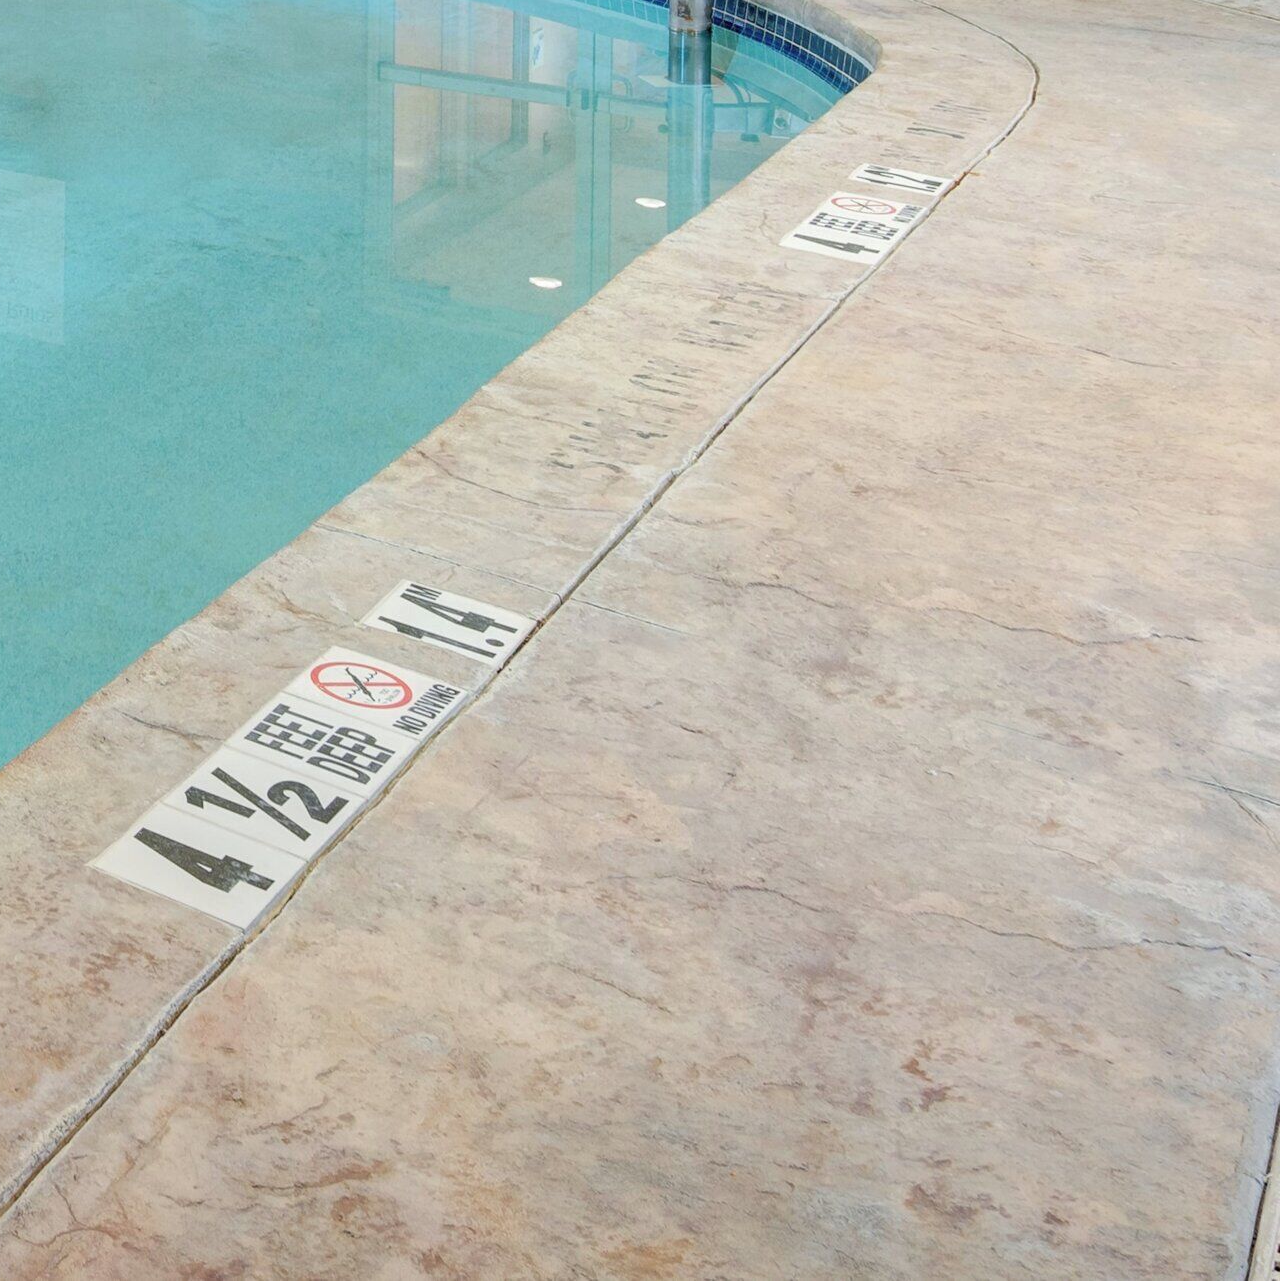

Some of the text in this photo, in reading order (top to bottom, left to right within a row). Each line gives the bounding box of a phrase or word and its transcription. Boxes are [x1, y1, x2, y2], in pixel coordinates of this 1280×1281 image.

[793, 233, 880, 254] 4
[809, 212, 858, 232] FEET
[850, 220, 899, 240] DEEP
[378, 583, 518, 658] 1.4 M
[244, 703, 334, 759] FEET
[392, 684, 460, 735] NO DIVING
[306, 726, 396, 785] DEEP
[134, 767, 350, 893] 4 1/2
